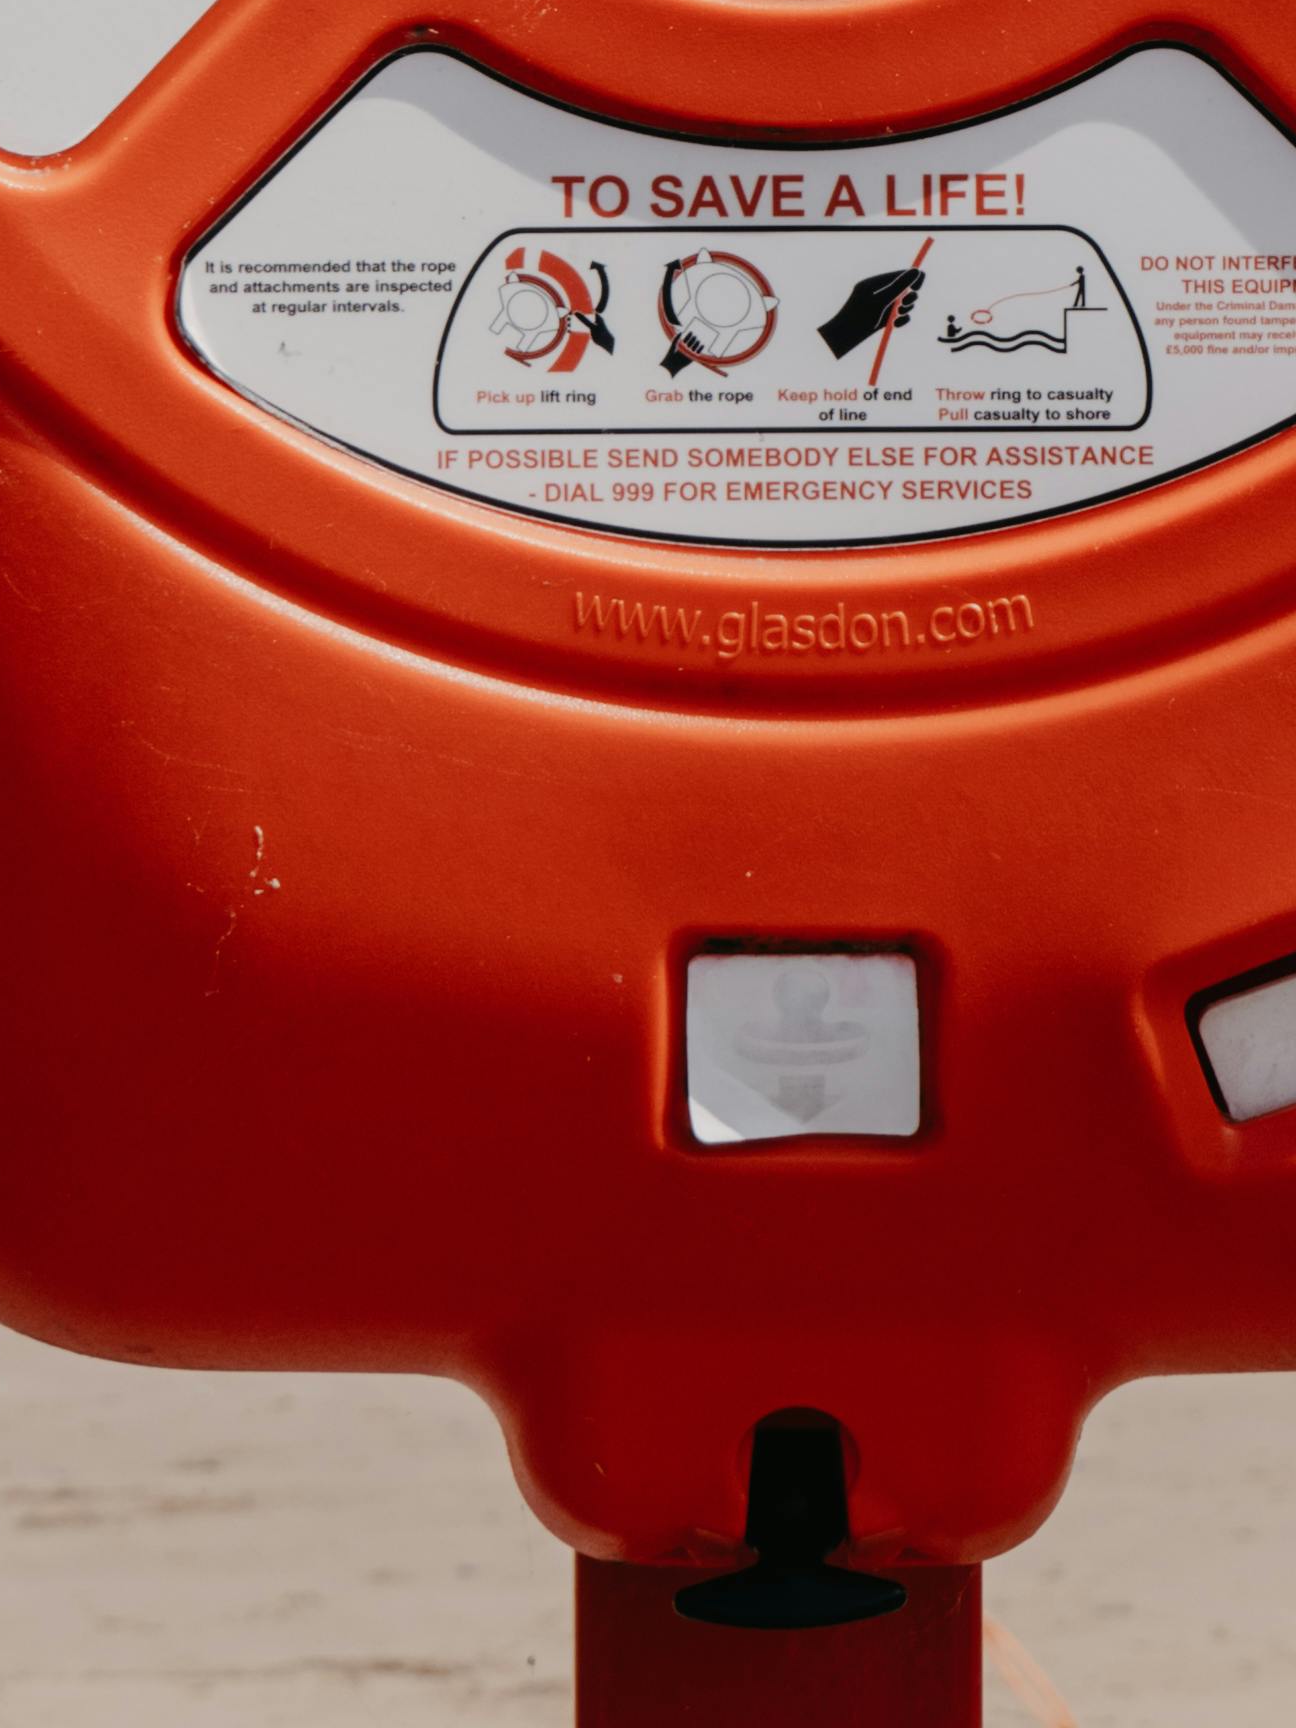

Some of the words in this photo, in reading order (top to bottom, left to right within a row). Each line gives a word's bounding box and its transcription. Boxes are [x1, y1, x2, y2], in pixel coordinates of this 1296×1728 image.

[550, 174, 630, 219] TO
[650, 174, 805, 219] SAVE
[824, 174, 865, 217] A
[885, 173, 1025, 217] LIFE!
[205, 260, 215, 274] It
[219, 261, 233, 274] is
[238, 260, 351, 274] recommended
[355, 260, 387, 273] that
[390, 259, 416, 273] the
[420, 262, 457, 276] rope
[1140, 255, 1170, 272] DO
[1175, 255, 1216, 271] NOT
[209, 281, 239, 294] and
[243, 280, 341, 294] attachments
[345, 282, 370, 293] are
[375, 279, 453, 296] inspected
[1181, 278, 1225, 295] THIS
[251, 301, 267, 314] at
[271, 300, 328, 317] regular
[1155, 301, 1192, 312] Under
[1194, 301, 1214, 311] the
[1216, 300, 1266, 312] Criminal
[1154, 317, 1176, 329] any
[1178, 317, 1220, 328] person
[1221, 315, 1257, 326] found
[1173, 330, 1236, 343] equipment
[1238, 331, 1264, 343] may
[1165, 344, 1204, 356] £5,000
[1206, 343, 1229, 355] fine
[1231, 344, 1270, 355] and/or
[476, 390, 511, 404] Pick
[515, 393, 536, 407] up
[540, 389, 561, 403] lift
[565, 390, 597, 407] ring
[644, 388, 685, 403] Grab
[688, 389, 713, 403] the
[718, 391, 754, 405] rope
[777, 388, 819, 405] Keep
[823, 387, 859, 402] hold
[862, 387, 879, 401] of
[882, 388, 913, 401] end
[935, 387, 986, 401] Throw
[990, 388, 1022, 404] ring
[1026, 388, 1043, 401] to
[1046, 387, 1114, 404] casualty
[818, 407, 835, 422] of
[839, 408, 868, 422] line
[939, 408, 968, 421] Pull
[973, 407, 1040, 424] casualty
[1046, 408, 1061, 421] to
[1066, 407, 1111, 421] shore
[437, 449, 459, 470] IF
[468, 448, 599, 470] POSSIBLE
[607, 447, 679, 469] SEND
[687, 447, 839, 468] SOMEBODY
[848, 446, 915, 467] ELSE
[922, 446, 977, 468] FOR
[985, 445, 1154, 467] ASSISTANCE
[544, 482, 604, 503] DIAL
[611, 482, 655, 502] 999
[663, 481, 717, 502] FOR
[726, 480, 894, 501] EMERGENCY
[901, 479, 1033, 501] SERVICES
[576, 592, 1035, 659] www.glasdon.com
